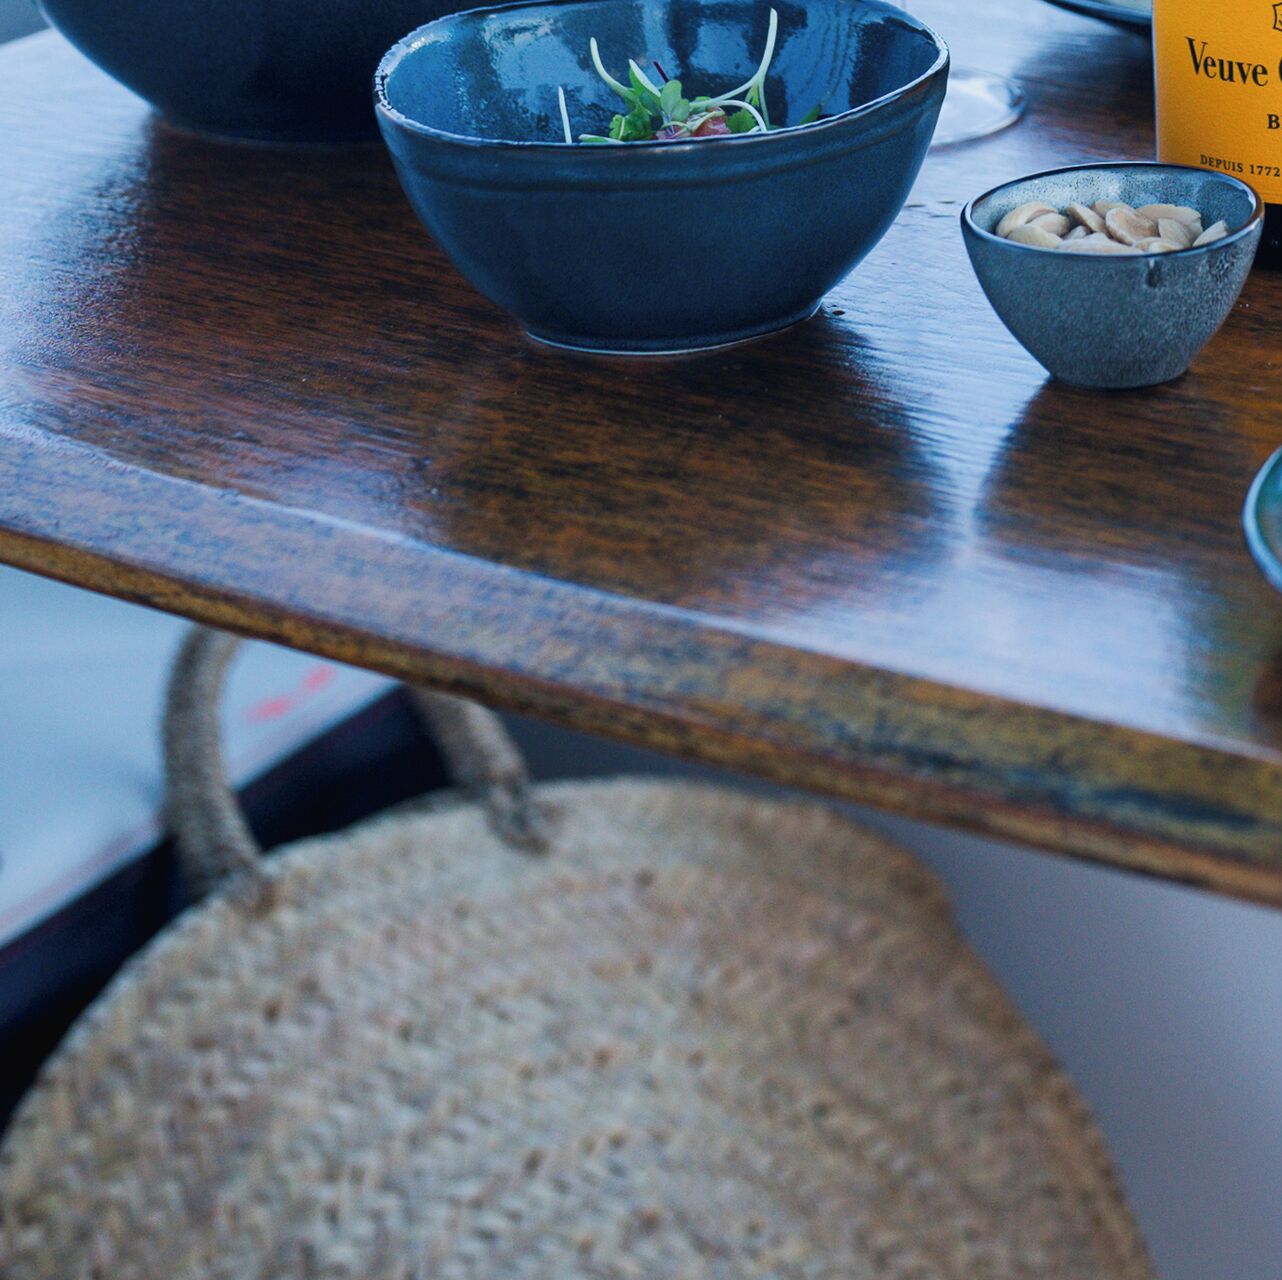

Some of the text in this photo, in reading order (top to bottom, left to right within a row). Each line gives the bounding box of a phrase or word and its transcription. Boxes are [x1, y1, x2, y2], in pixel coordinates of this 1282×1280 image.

[1185, 36, 1268, 86] Veuve
[1201, 155, 1243, 173] DEPUIS
[1250, 165, 1281, 178] 1772
